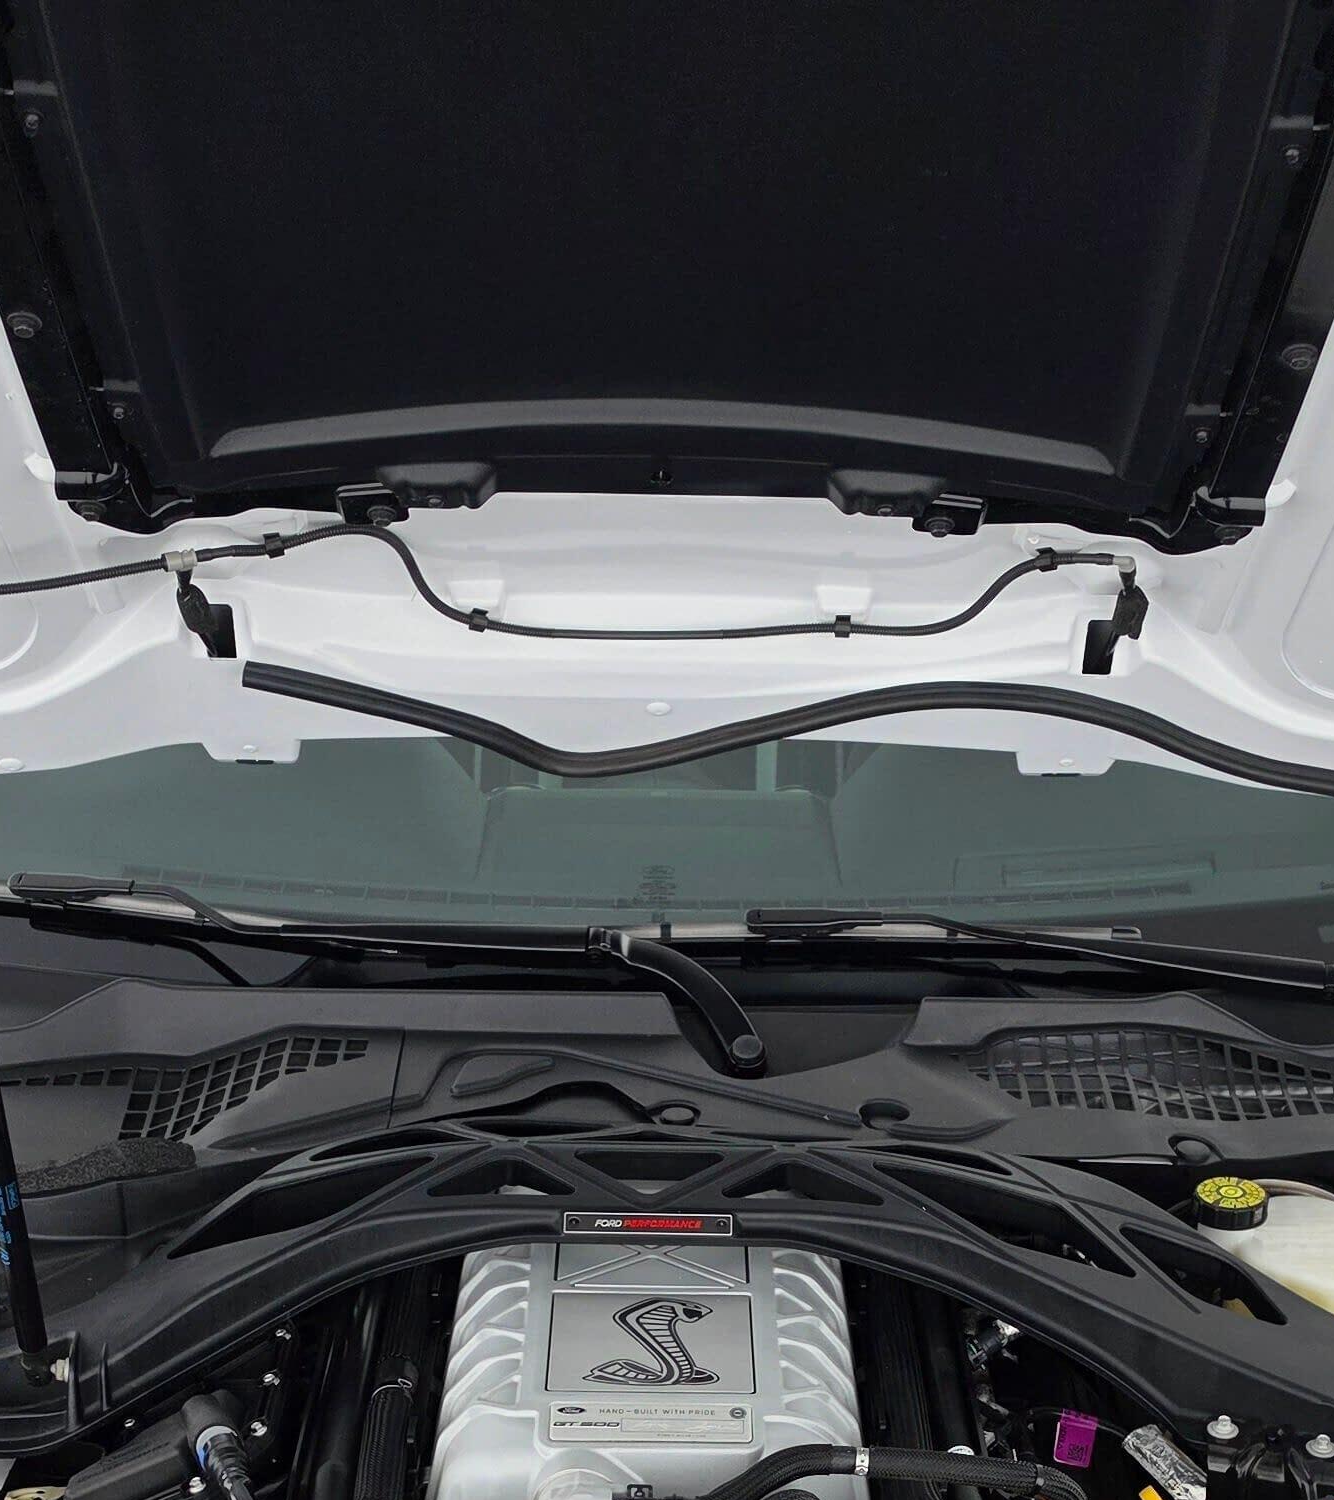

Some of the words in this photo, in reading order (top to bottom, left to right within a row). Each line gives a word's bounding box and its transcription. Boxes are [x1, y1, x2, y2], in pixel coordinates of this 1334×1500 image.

[595, 1219, 622, 1228] FORD
[623, 1219, 703, 1229] PERFORMANCE
[688, 1408, 716, 1416] PRIDE
